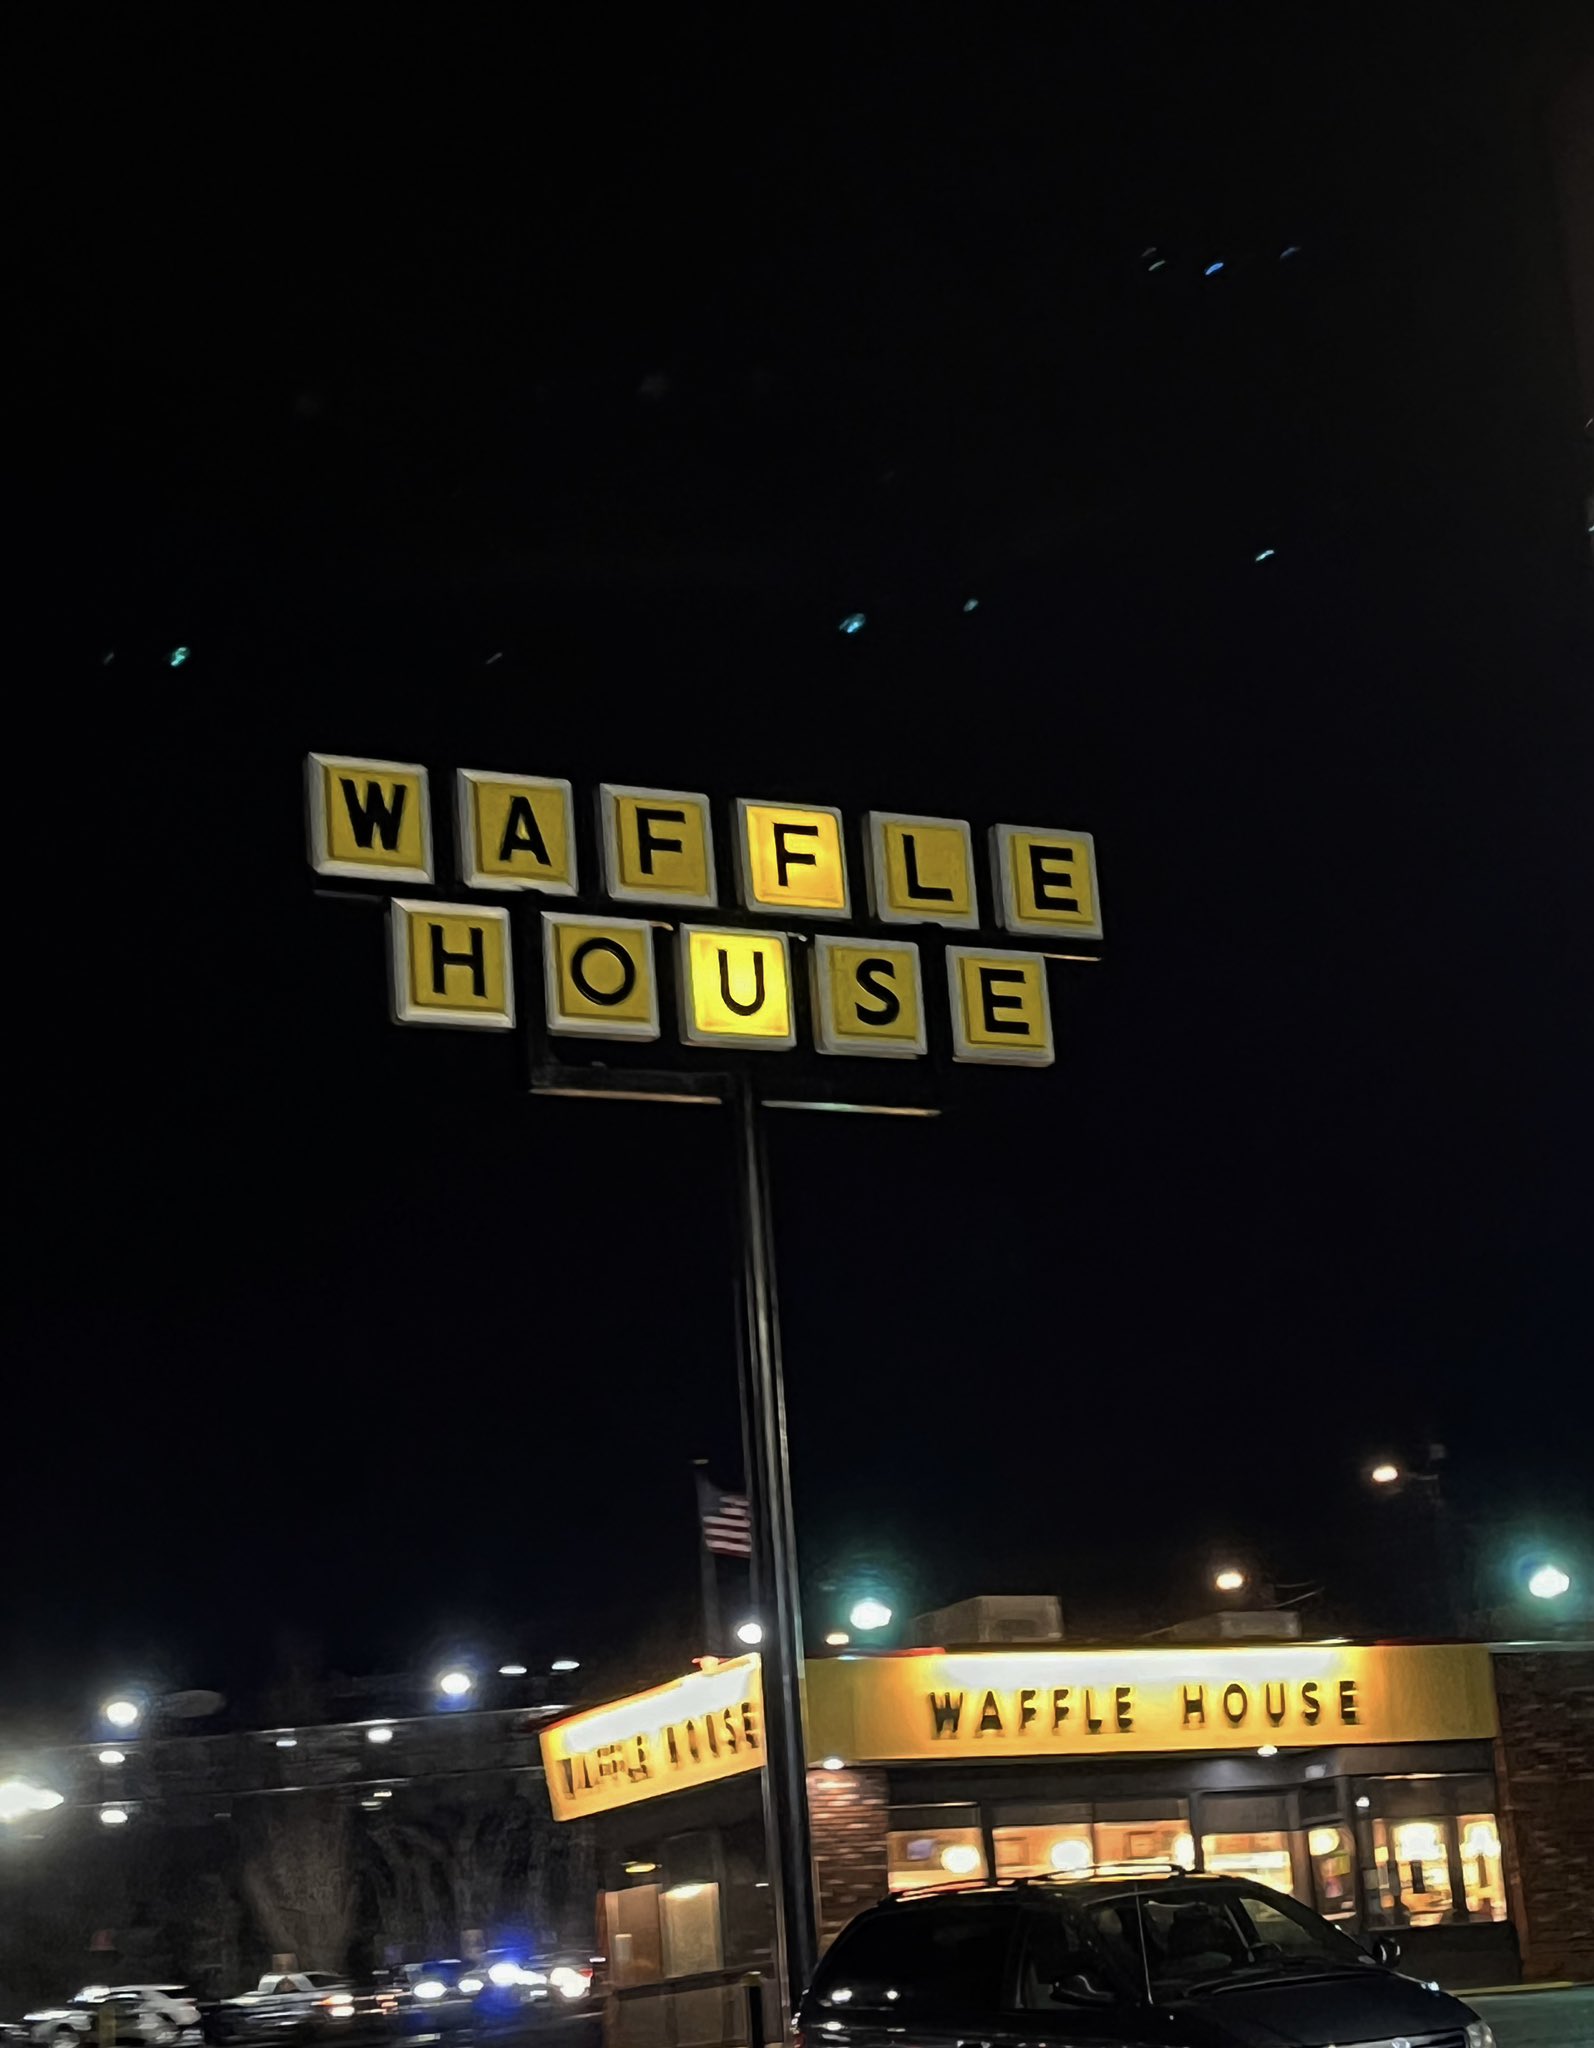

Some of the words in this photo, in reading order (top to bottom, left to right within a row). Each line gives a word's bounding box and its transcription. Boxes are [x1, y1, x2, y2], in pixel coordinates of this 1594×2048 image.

[339, 778, 1081, 913] WAFFLE
[429, 923, 1032, 1035] HOUSE
[929, 1686, 1135, 1738] WAFFLE
[1182, 1680, 1364, 1726] HOUSE
